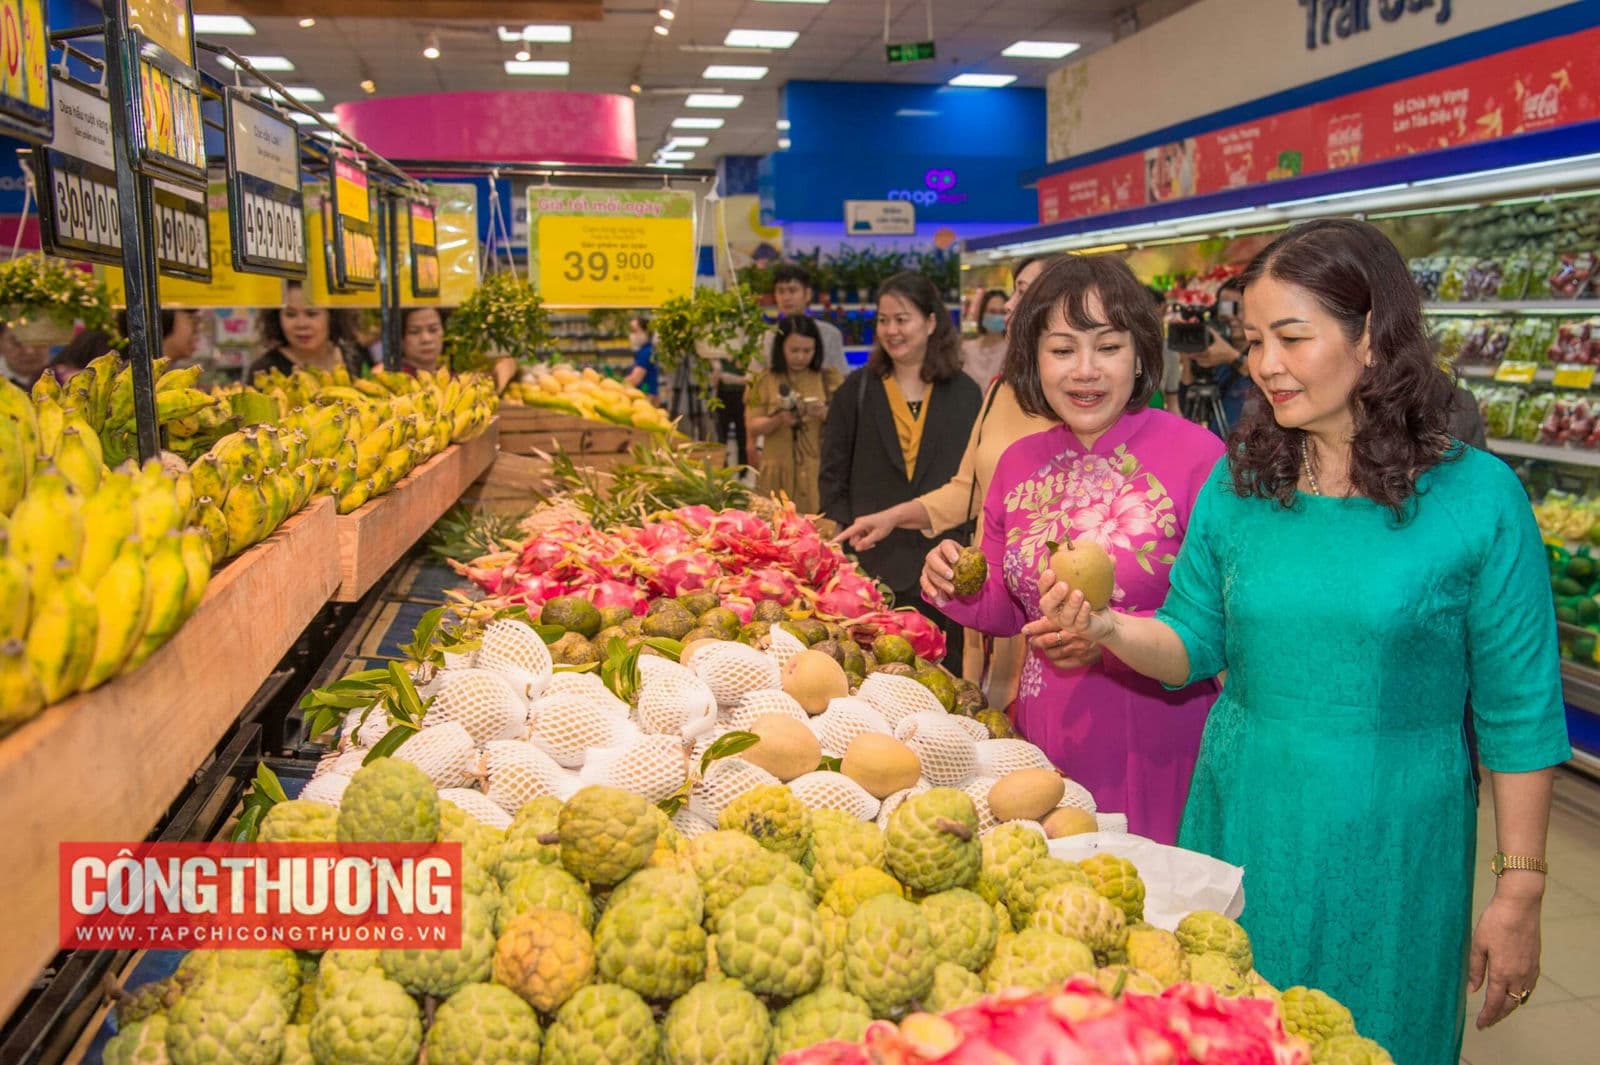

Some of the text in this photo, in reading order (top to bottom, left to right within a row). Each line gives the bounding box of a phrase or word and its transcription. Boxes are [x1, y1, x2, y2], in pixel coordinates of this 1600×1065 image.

[57, 181, 119, 236] 30.900
[246, 202, 293, 251] 49.900
[536, 196, 663, 216] Giá tốt mỗi ngày
